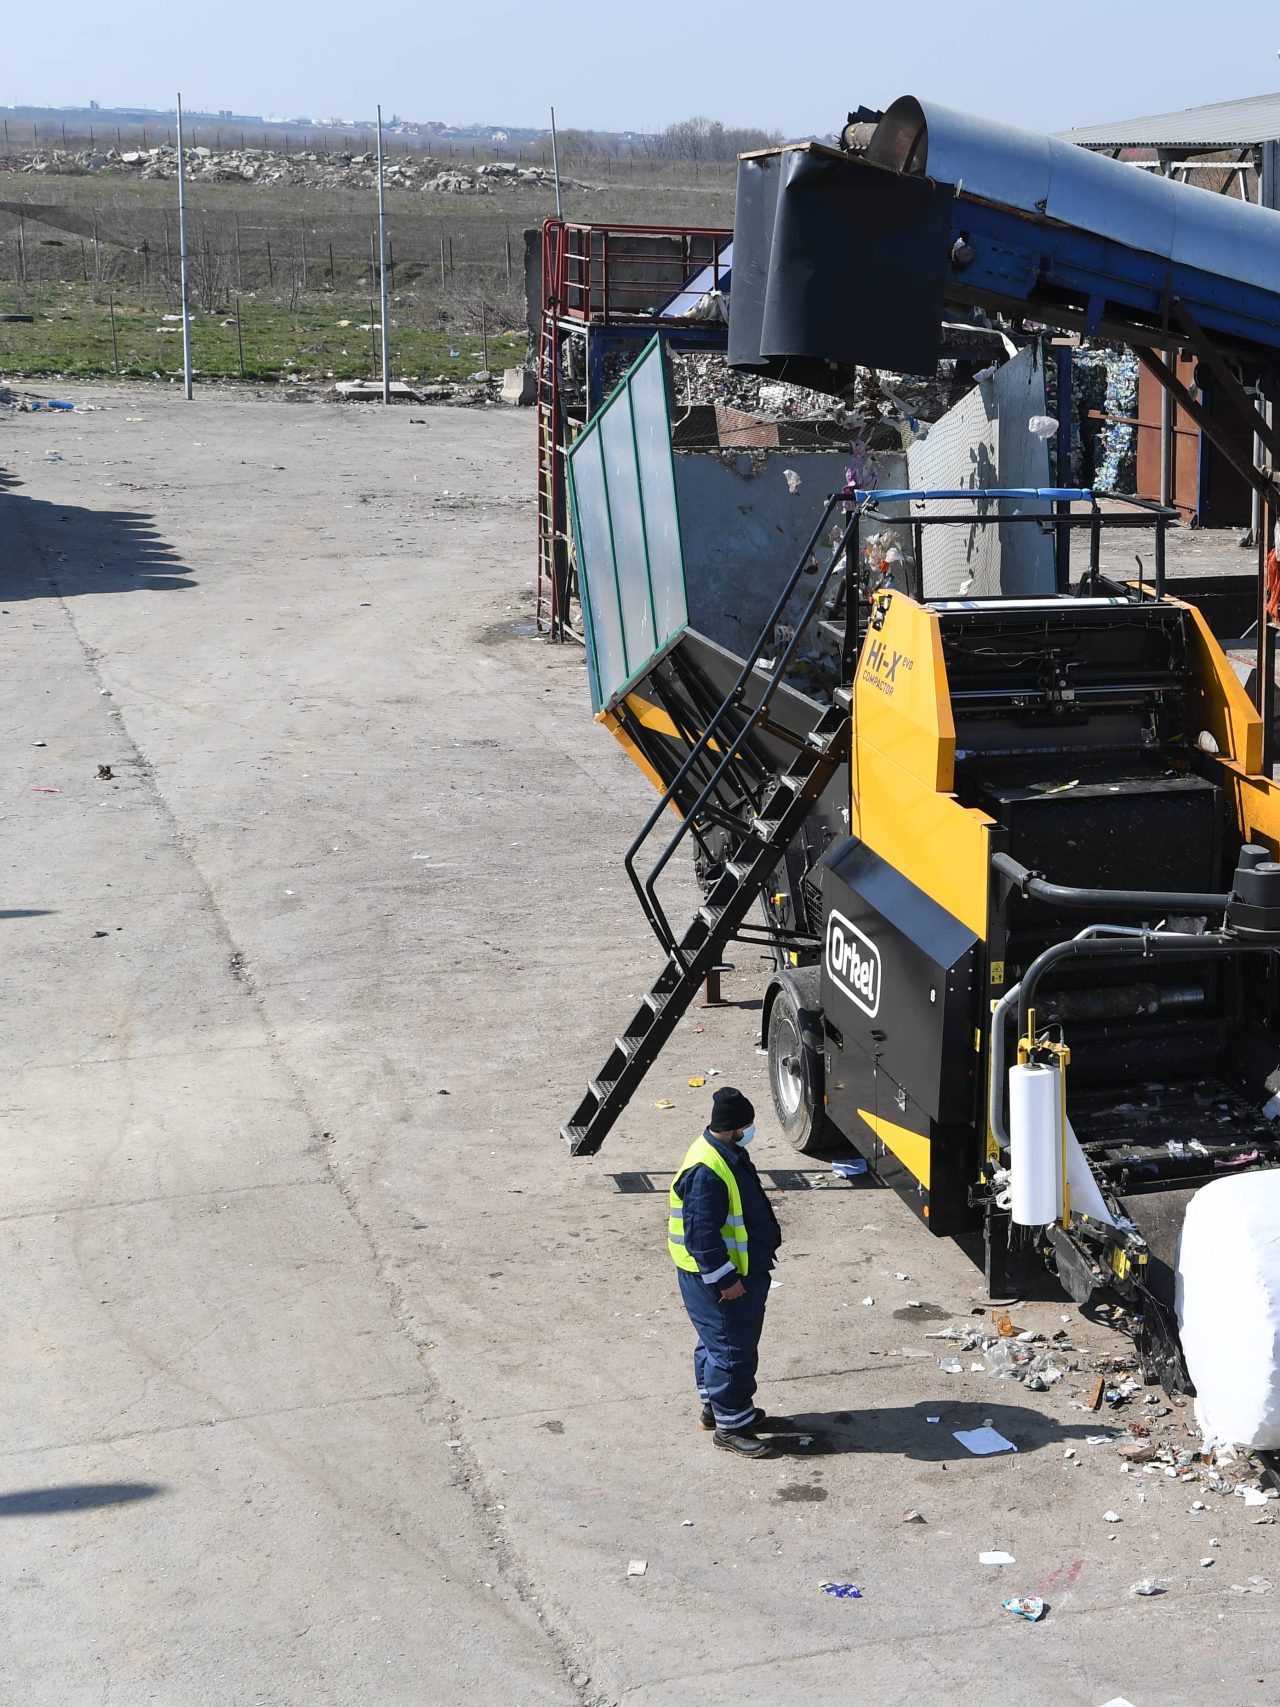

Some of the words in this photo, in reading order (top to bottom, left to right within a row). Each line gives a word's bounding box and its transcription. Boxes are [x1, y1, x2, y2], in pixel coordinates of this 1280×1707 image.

[862, 669, 895, 696] COMPACTOR
[865, 639, 902, 683] Hi-X
[902, 657, 914, 671] evo
[831, 926, 875, 1002] Orkel
